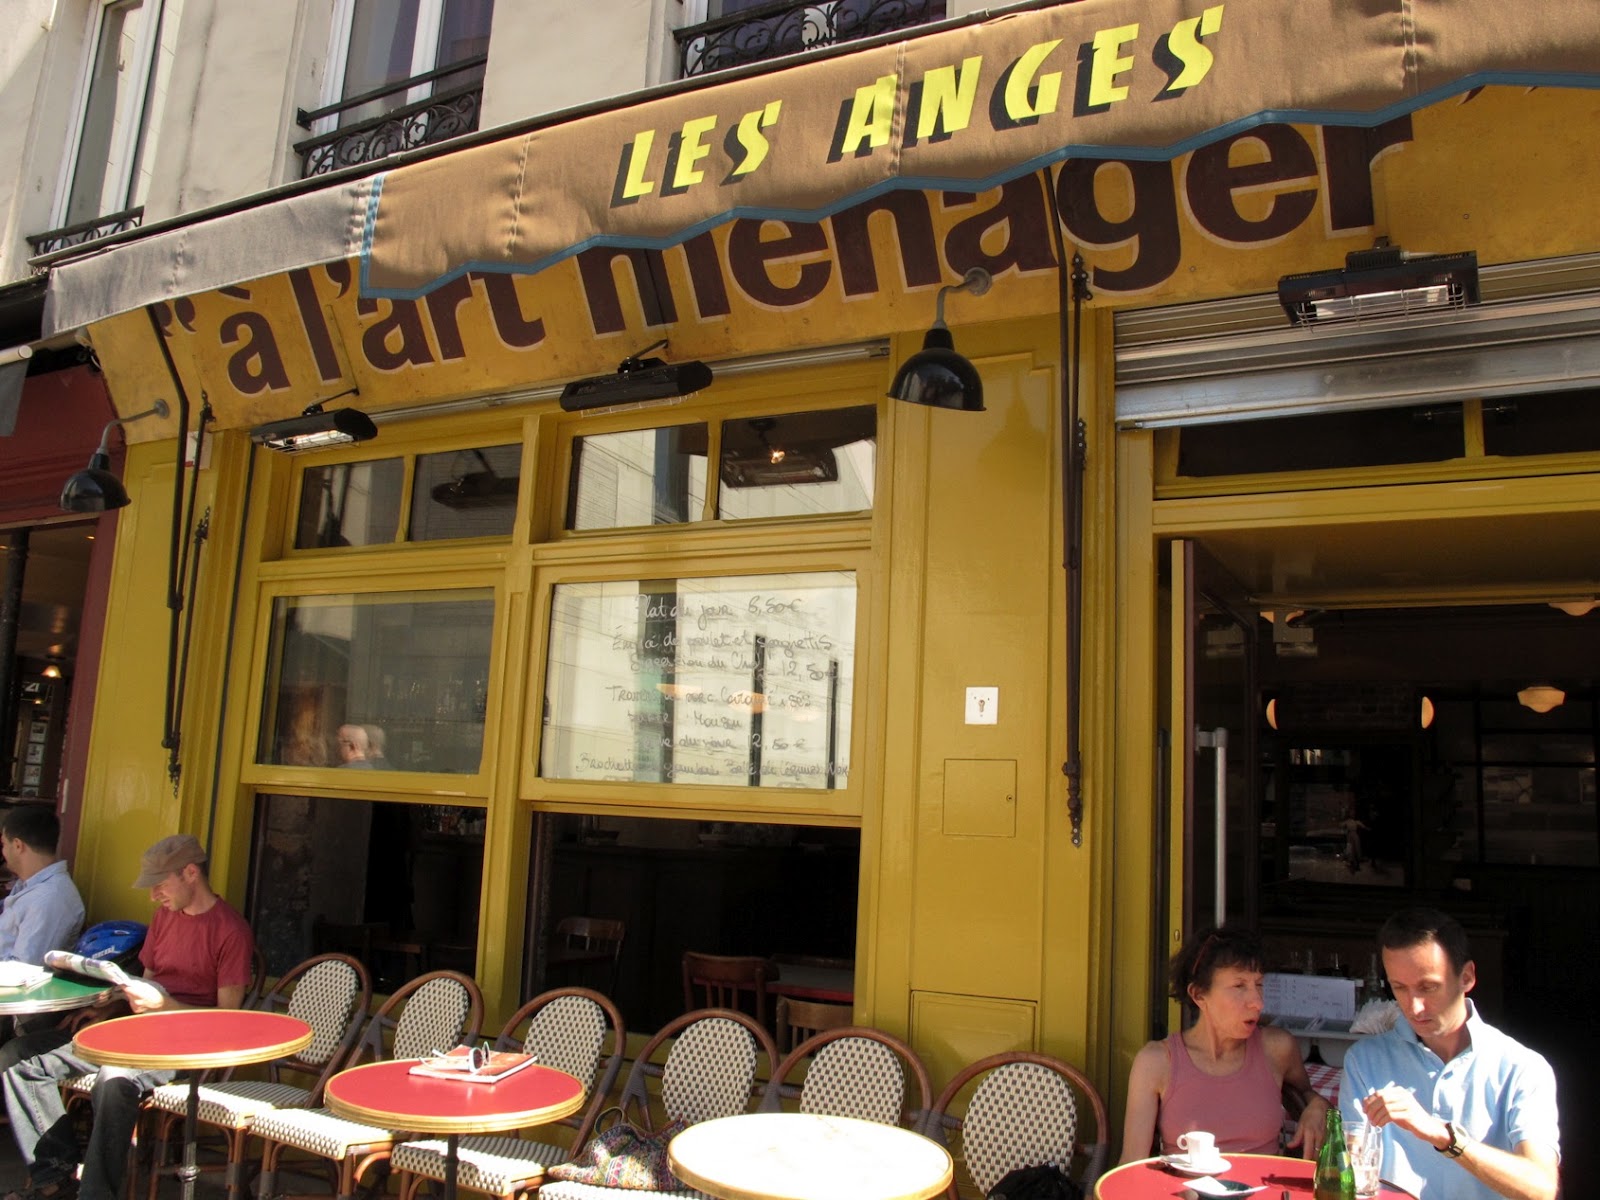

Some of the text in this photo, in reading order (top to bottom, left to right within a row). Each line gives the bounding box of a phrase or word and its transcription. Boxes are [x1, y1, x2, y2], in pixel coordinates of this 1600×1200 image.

[615, 5, 1224, 204] LES ANGES
[635, 594, 667, 619] Plat
